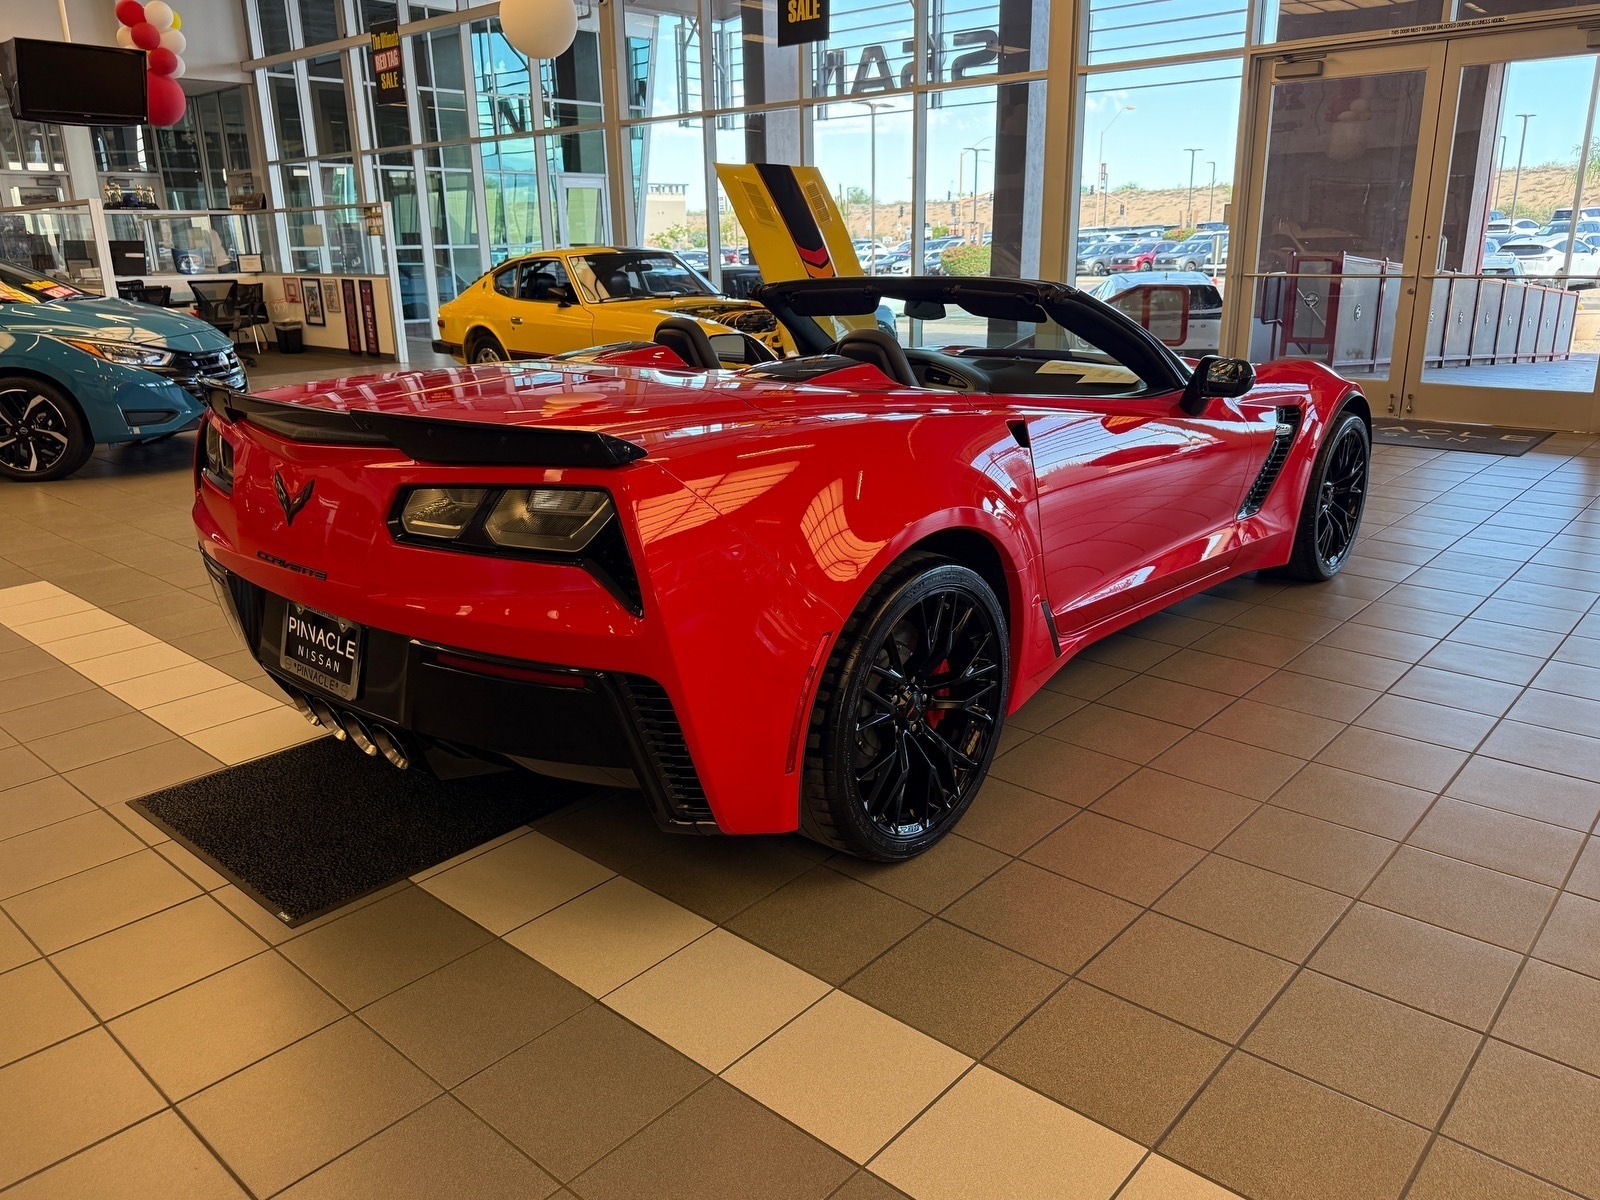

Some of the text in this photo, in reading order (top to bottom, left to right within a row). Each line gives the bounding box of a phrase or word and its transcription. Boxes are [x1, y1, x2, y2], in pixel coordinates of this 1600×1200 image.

[787, 0, 821, 24] SALE
[372, 34, 381, 51] The
[375, 50, 399, 71] RED TAG
[381, 71, 399, 90] SALE
[1371, 423, 1537, 443] ACLE
[256, 550, 328, 581] CORVETTE
[288, 616, 356, 660] PINNACLE
[297, 644, 341, 673] NISSAN
